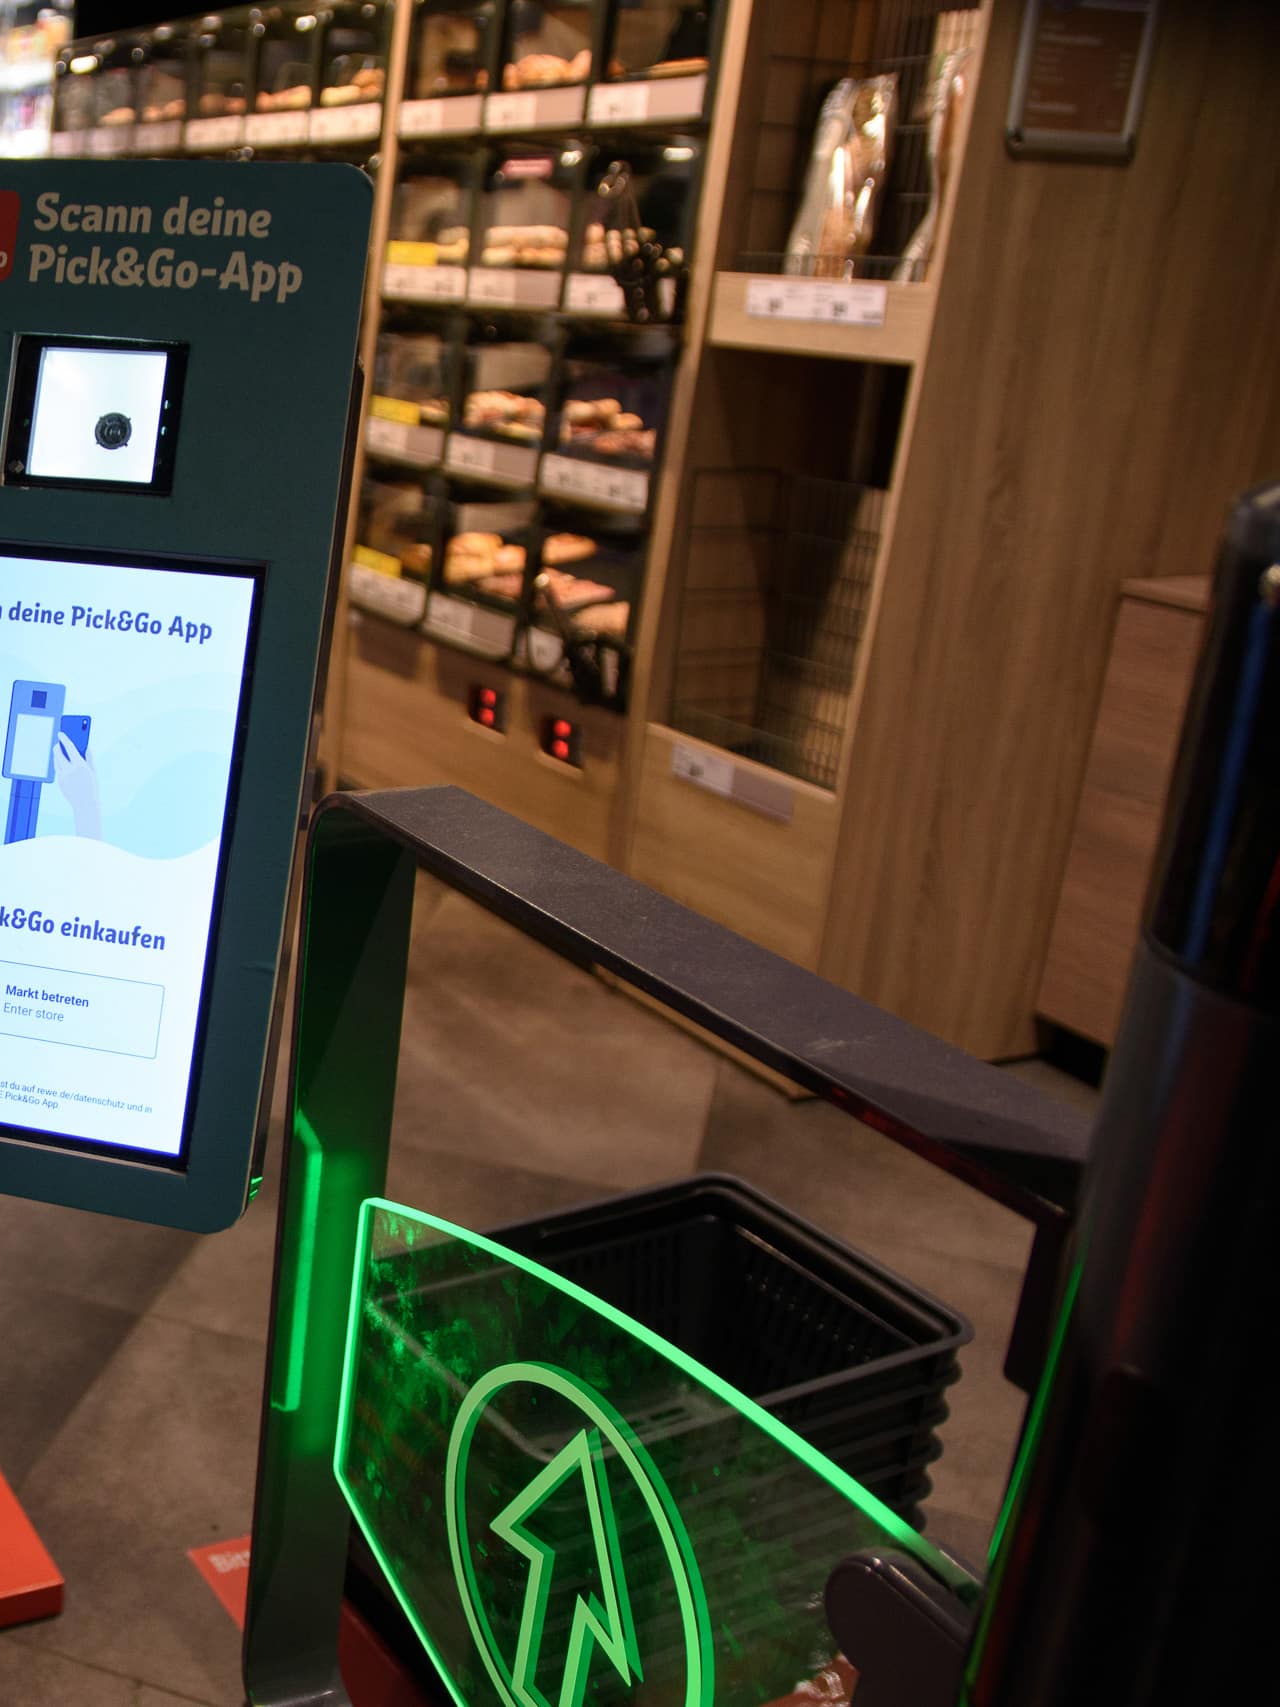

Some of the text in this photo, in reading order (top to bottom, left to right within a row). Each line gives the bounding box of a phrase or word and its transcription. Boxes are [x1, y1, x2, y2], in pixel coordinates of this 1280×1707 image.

[34, 192, 271, 238] Scann deine
[28, 244, 303, 303] Pick&Go-App
[8, 601, 65, 625] deine
[71, 605, 162, 635] Pick&Go
[168, 615, 213, 645] App
[60, 916, 167, 951] einkaufen
[5, 984, 89, 1008] Markt betreten
[3, 1001, 65, 1022] Enter store
[5, 1091, 40, 1106] Pick&Go
[42, 1097, 59, 1110] App
[9, 1080, 20, 1091] du
[21, 1084, 36, 1094] auf
